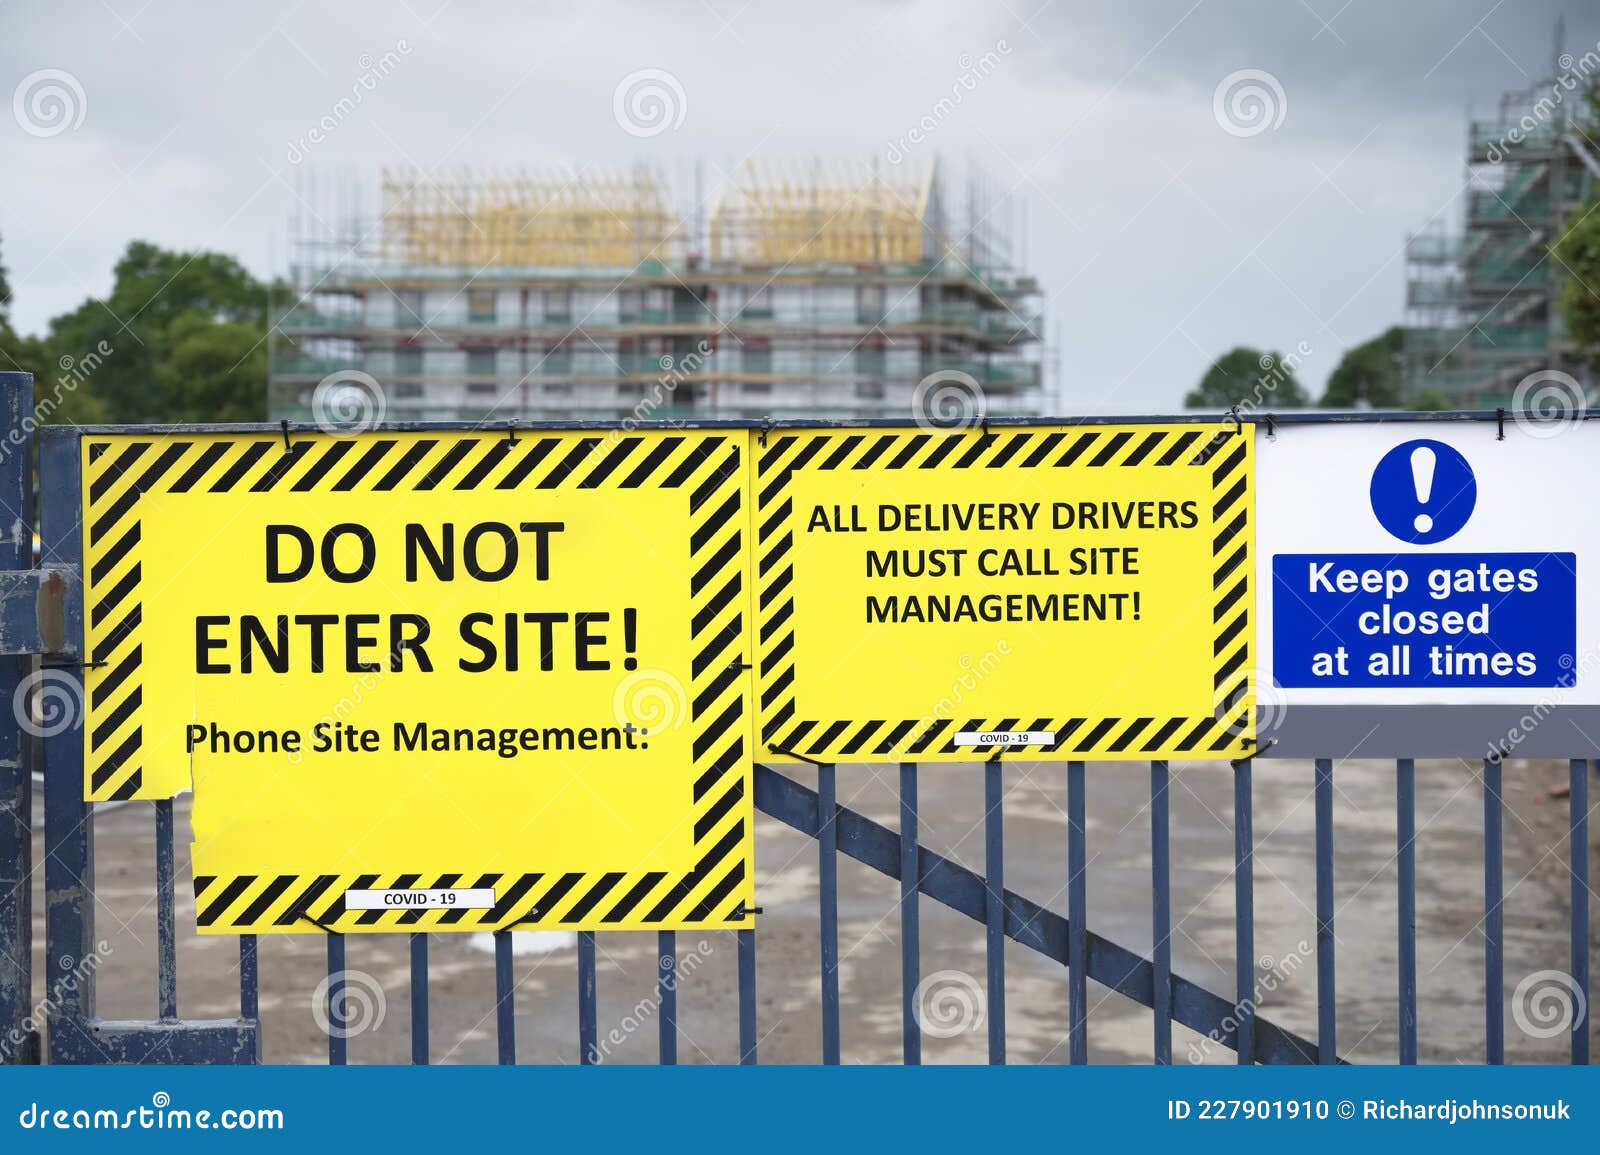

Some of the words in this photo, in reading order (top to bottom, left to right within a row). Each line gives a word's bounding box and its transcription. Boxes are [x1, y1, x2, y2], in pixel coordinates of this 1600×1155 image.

[808, 505, 867, 532] ALL
[879, 503, 1040, 531] DELIVERY
[1053, 501, 1198, 529] DRIVERS
[266, 523, 375, 583] DO
[405, 521, 565, 582] NOT
[867, 550, 967, 577] MUST
[978, 549, 1059, 576] CALL
[1070, 548, 1139, 575] SITE
[1309, 563, 1408, 599] Keep
[1428, 566, 1539, 599] gates
[866, 592, 1140, 623] MANAGEMENT!
[1358, 604, 1489, 635] closed
[196, 613, 434, 674] ENTER
[458, 608, 638, 672] SITE!
[1312, 646, 1349, 676] at
[1368, 645, 1410, 676] all
[1429, 645, 1537, 676] times
[186, 722, 301, 753] Phone
[313, 721, 380, 752] Site
[393, 722, 649, 759] Management:
[980, 734, 1009, 743] COVID
[1018, 734, 1029, 742] 19
[384, 893, 427, 905] COVID
[440, 893, 456, 904] 19
